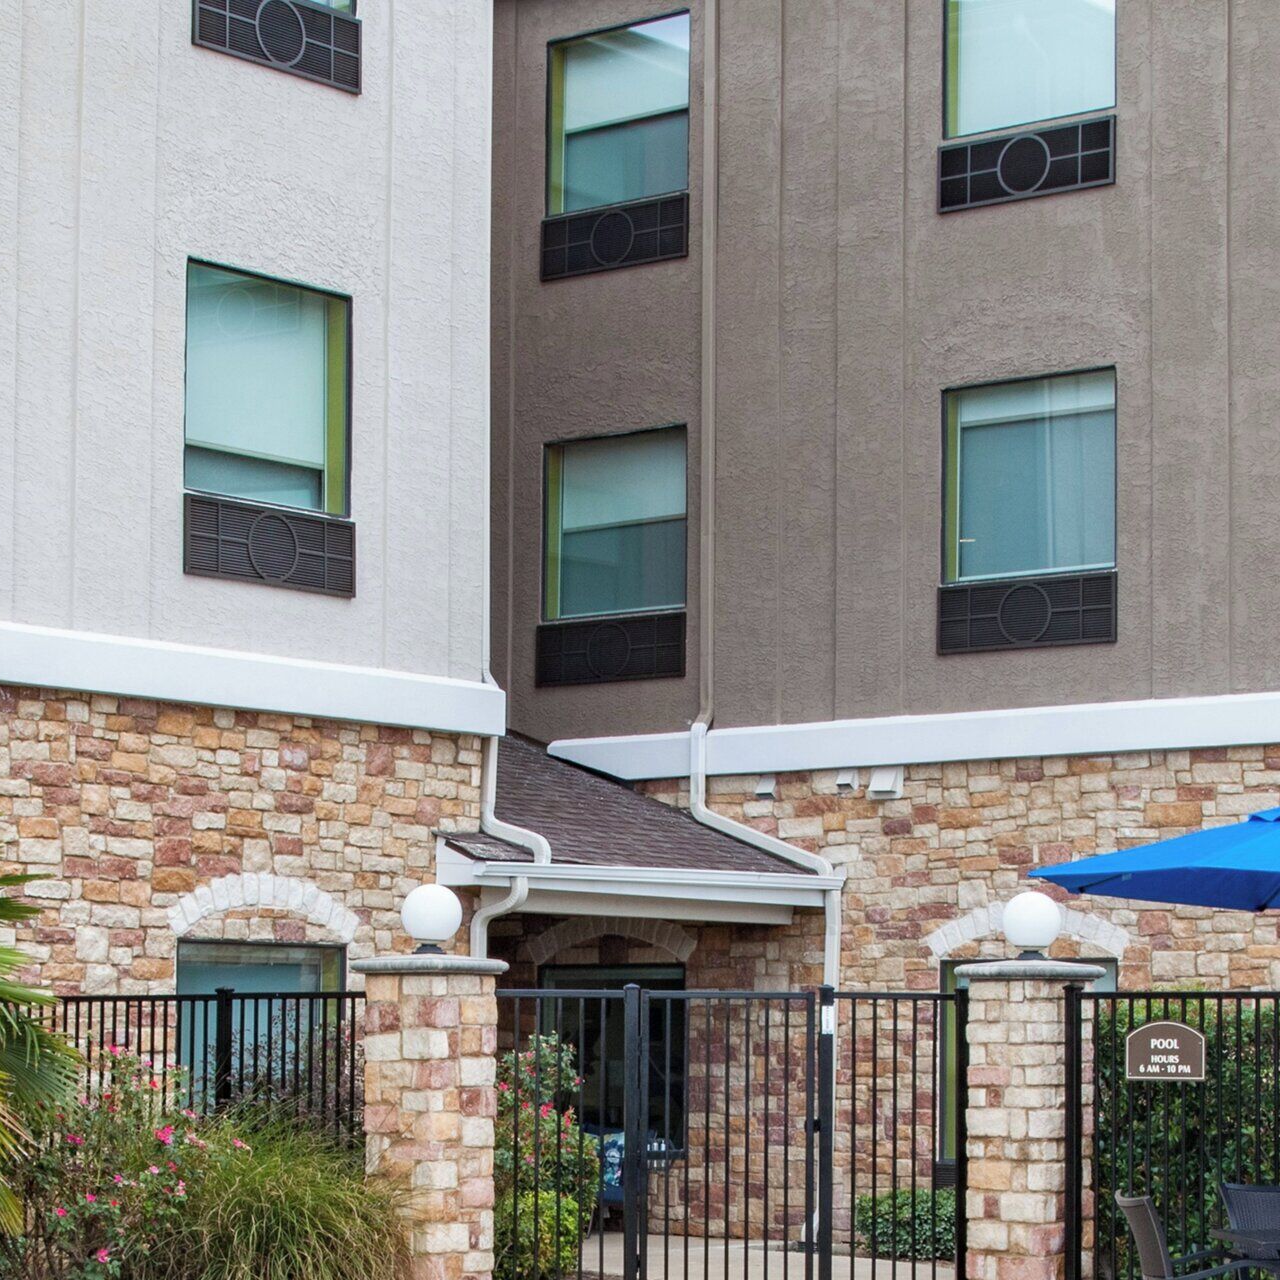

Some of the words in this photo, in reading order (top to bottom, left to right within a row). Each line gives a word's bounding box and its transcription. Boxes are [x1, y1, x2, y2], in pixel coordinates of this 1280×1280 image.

[1150, 1039, 1180, 1049] POOL
[1151, 1055, 1180, 1064] HOURS
[1139, 1064, 1145, 1073] 6
[1147, 1064, 1160, 1073] AM
[1166, 1064, 1176, 1073] 10
[1178, 1064, 1191, 1074] PM
